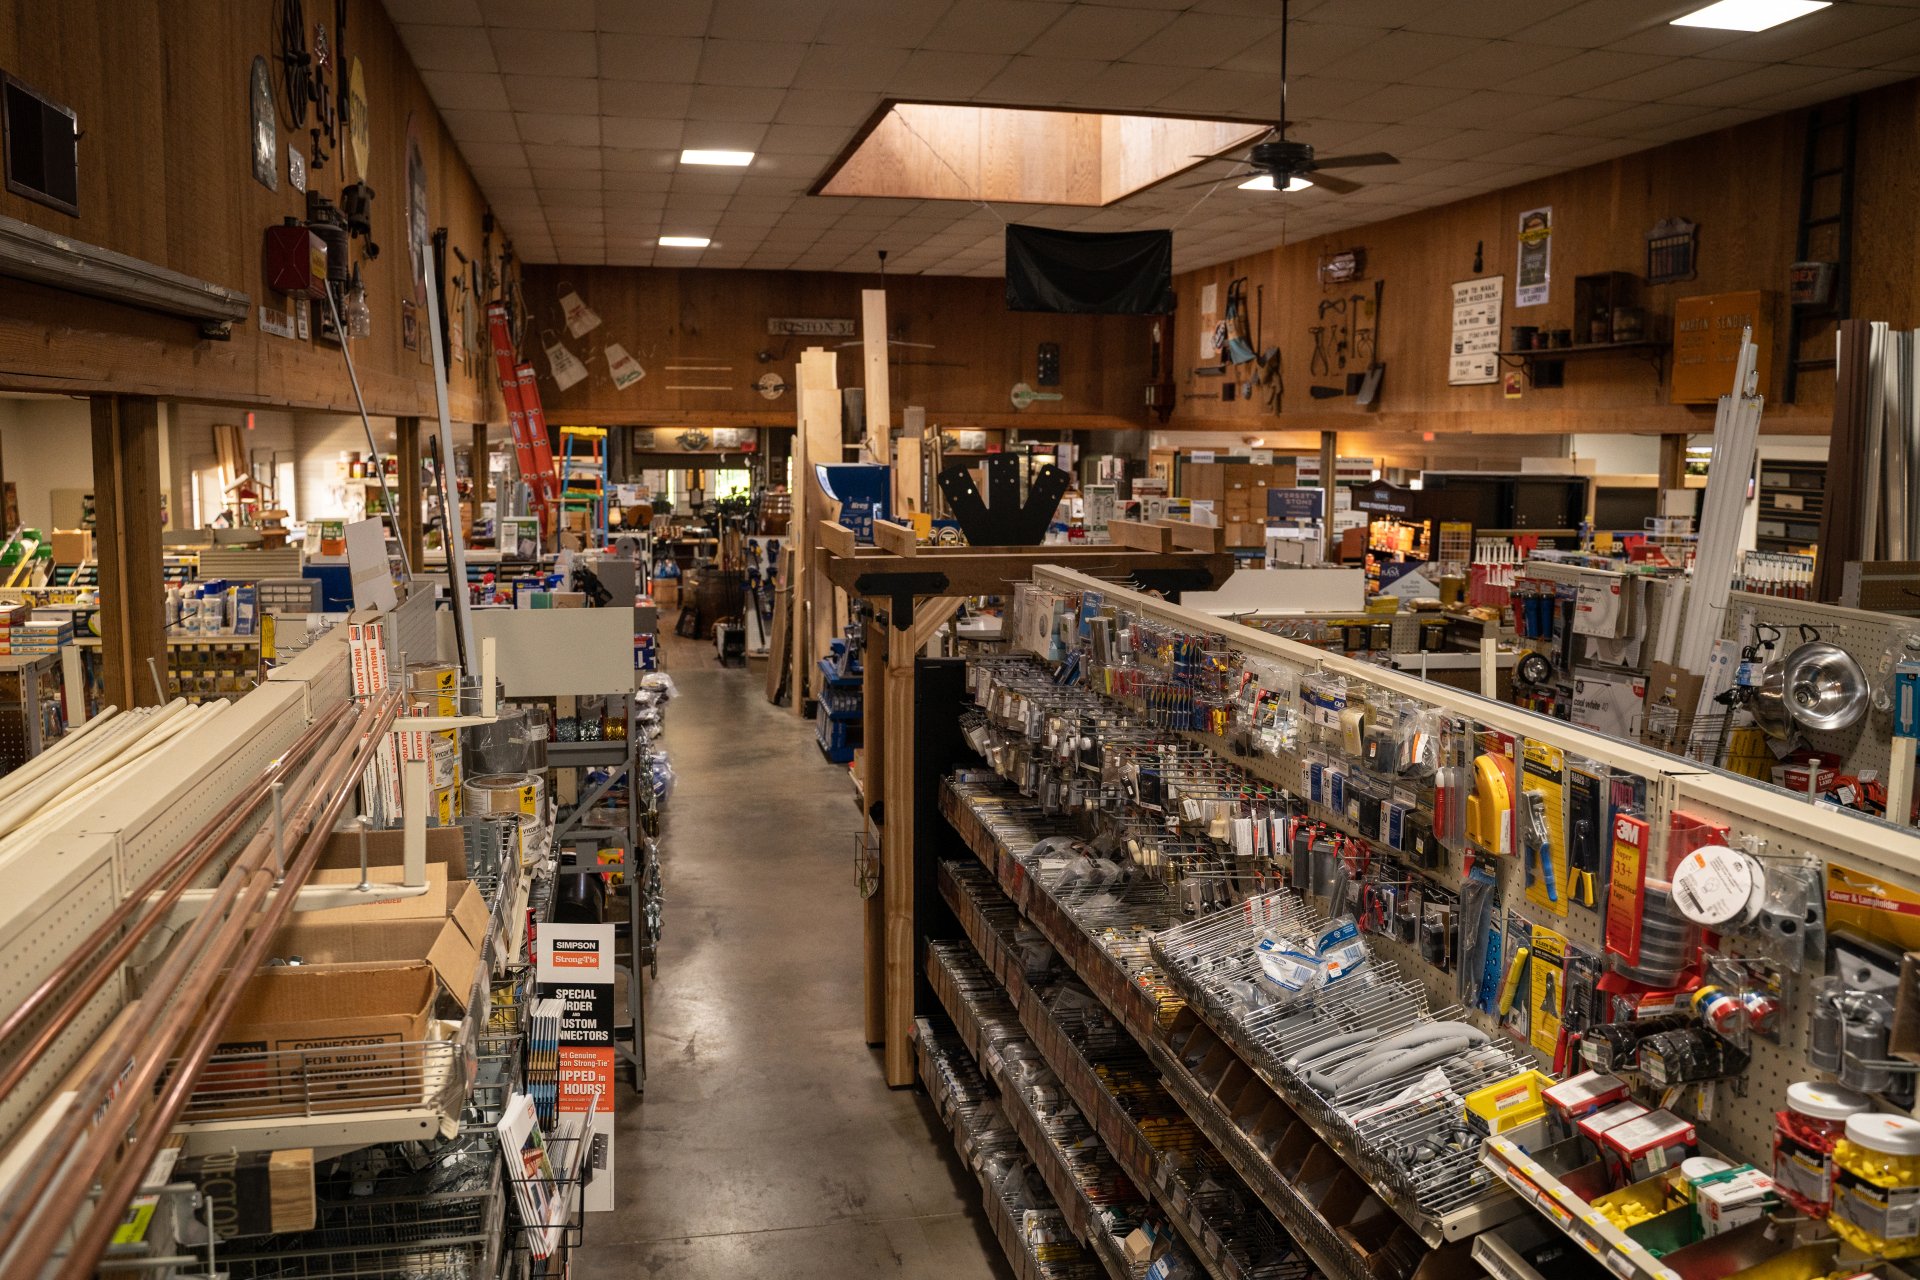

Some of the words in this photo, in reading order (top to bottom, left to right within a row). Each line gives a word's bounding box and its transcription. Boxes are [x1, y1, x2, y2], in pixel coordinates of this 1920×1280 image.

[354, 648, 365, 695] INSULATION
[1573, 698, 1585, 707] cool
[1585, 700, 1600, 710] white
[401, 731, 409, 760] SULATIO
[416, 731, 424, 760] SULATIO
[1302, 769, 1309, 780] 15
[1818, 772, 1835, 781] CLAMP
[1819, 778, 1833, 787] LAMP
[1616, 819, 1640, 845] 3M
[1616, 849, 1633, 861] Super
[1614, 861, 1633, 877] 33+
[1613, 879, 1637, 895] Electrical
[1613, 890, 1625, 901] Tape
[1829, 890, 1850, 902] Cover
[1851, 894, 1858, 903] &
[1858, 895, 1900, 911] Lampholder
[556, 941, 596, 949] SIMPSON
[1549, 944, 1561, 953] TOOLS
[555, 955, 597, 965] Strong-Tie
[555, 988, 597, 1000] SPECIAL
[562, 1018, 598, 1029] USTOM
[559, 1030, 609, 1041] NNECTORS
[294, 1038, 385, 1052] CONNECTORS
[305, 1056, 332, 1066] FOR
[335, 1054, 377, 1065] WOOD
[569, 1051, 597, 1059] Genuine
[573, 1060, 608, 1068] Strong-Tie
[559, 1070, 596, 1082] HIPPED
[598, 1074, 606, 1082] in
[564, 1084, 606, 1095] HOURS!
